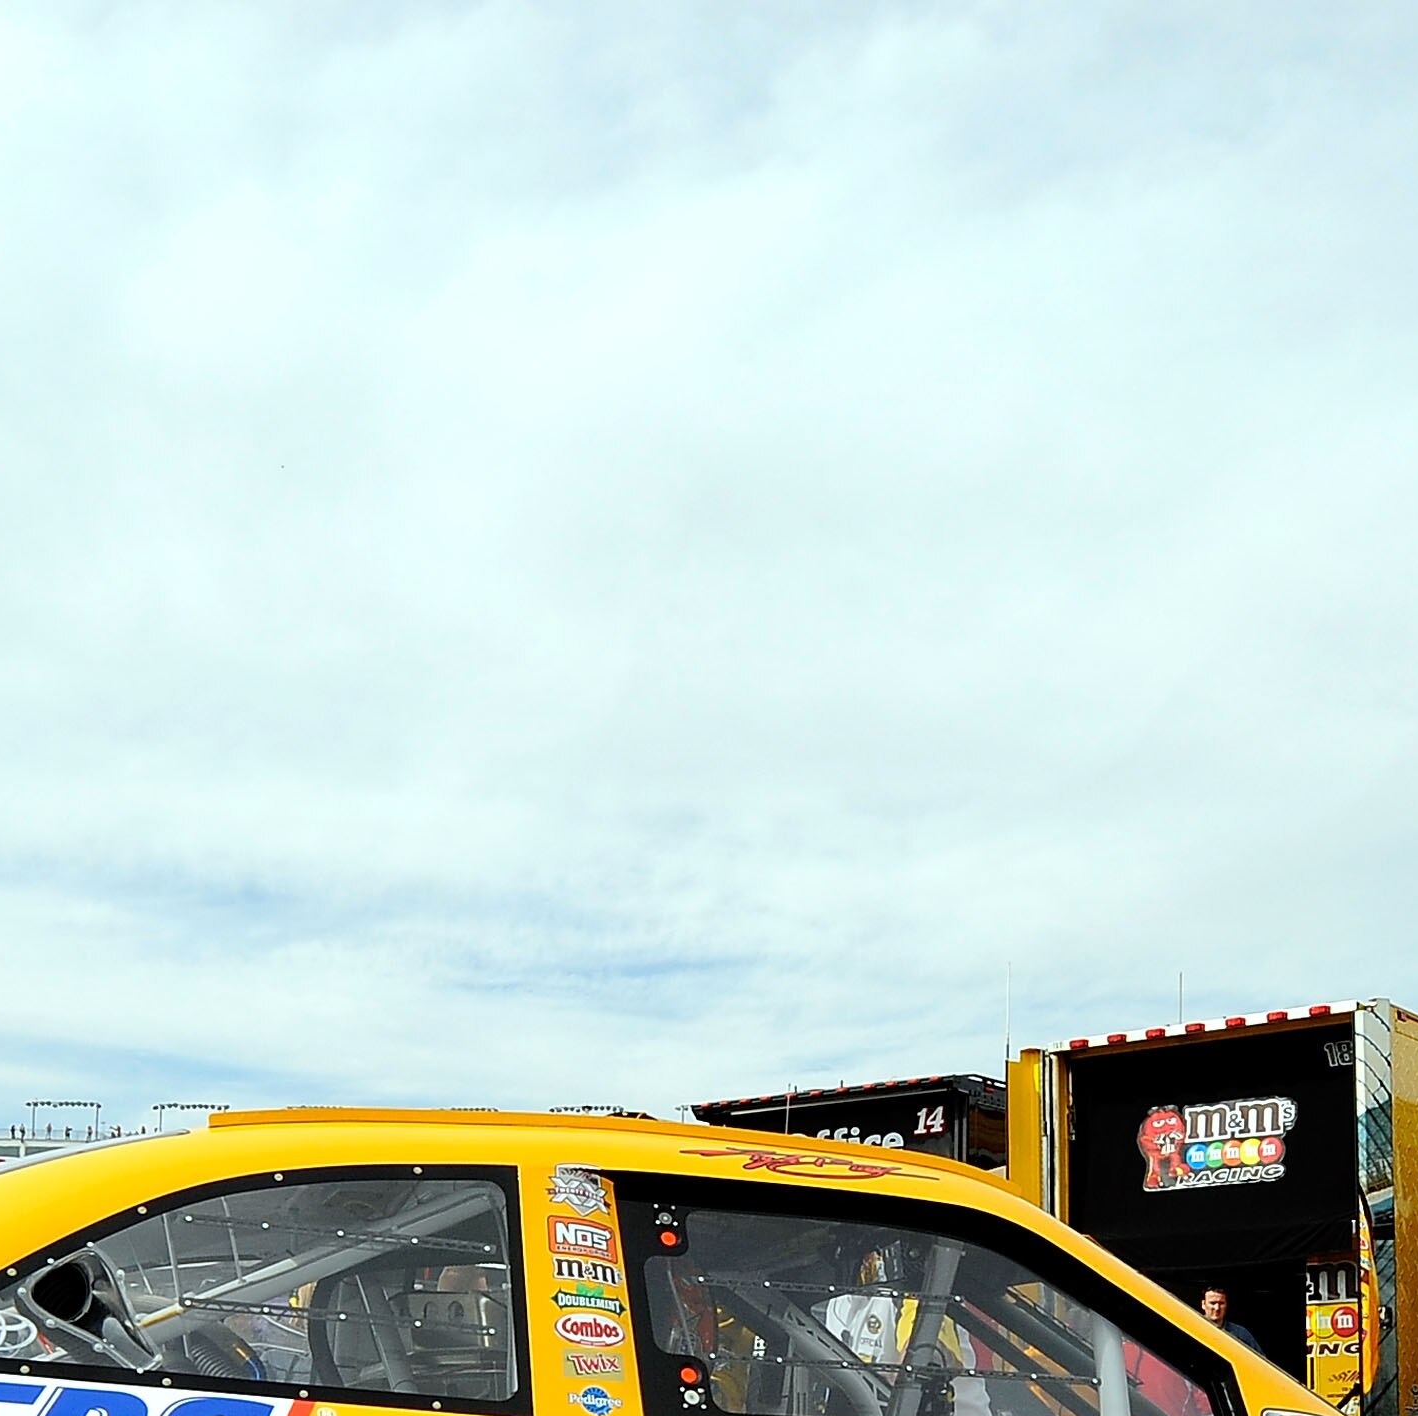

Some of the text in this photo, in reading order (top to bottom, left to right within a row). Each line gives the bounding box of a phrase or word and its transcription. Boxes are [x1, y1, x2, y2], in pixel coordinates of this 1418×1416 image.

[1324, 1041, 1354, 1067] 18
[913, 1105, 945, 1135] 14
[1175, 1164, 1286, 1187] RACING
[555, 1220, 613, 1251] NOS
[556, 1292, 622, 1314] DOUBLEMINT
[561, 1317, 620, 1338] Combos
[566, 1353, 622, 1375] Twix
[568, 1392, 624, 1408] Pedigree
